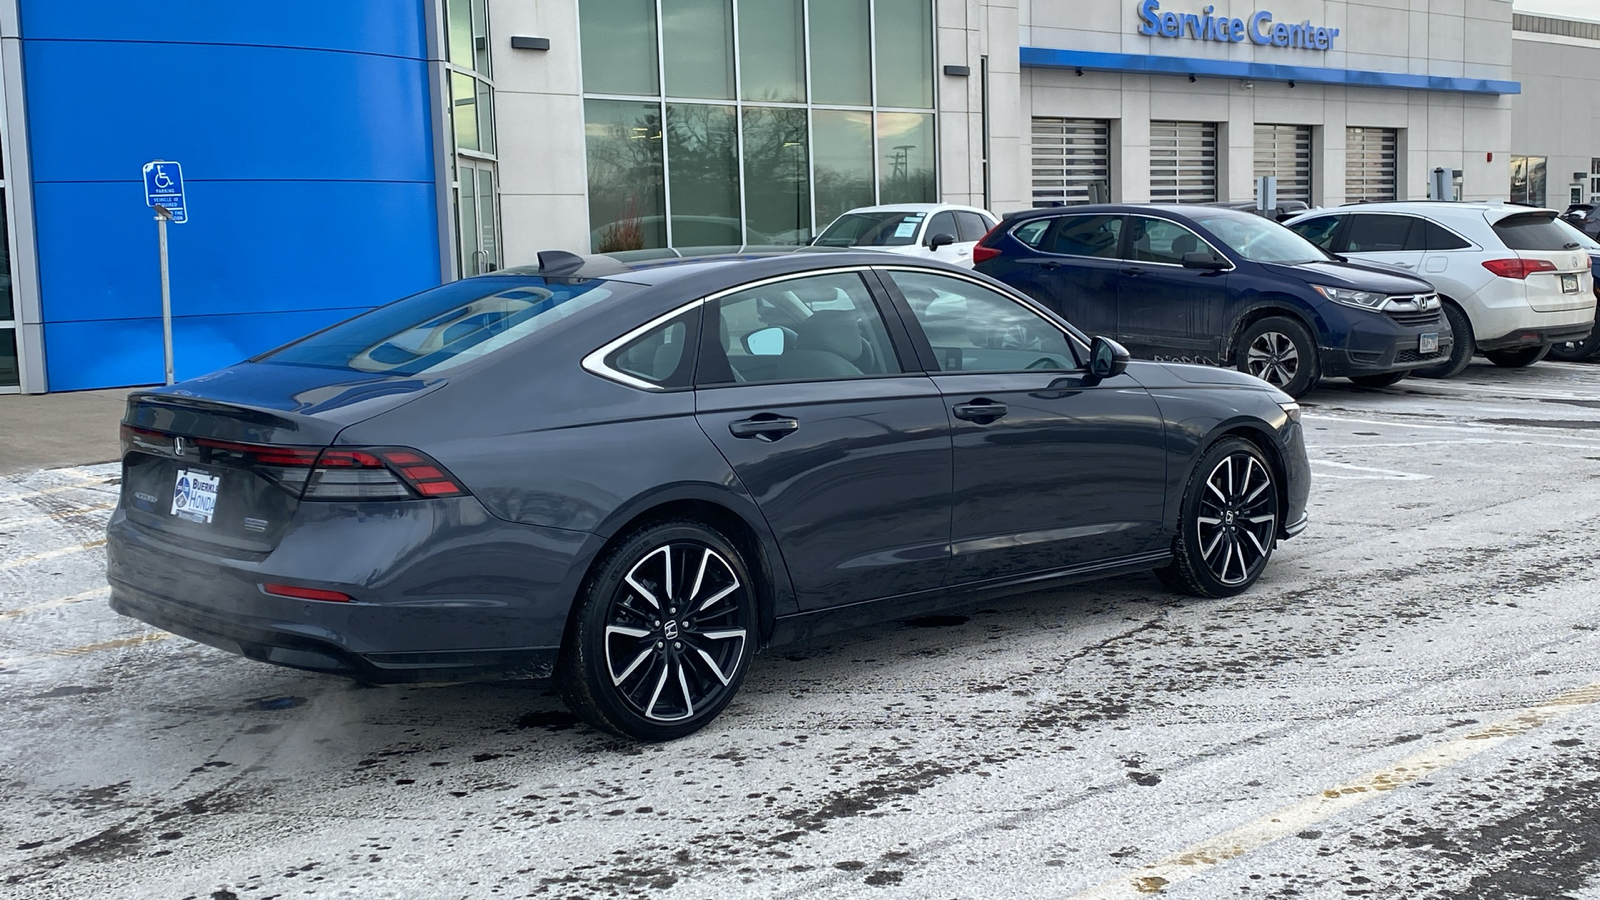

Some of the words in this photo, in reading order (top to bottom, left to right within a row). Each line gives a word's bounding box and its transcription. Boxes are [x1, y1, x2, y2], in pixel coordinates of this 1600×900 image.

[1138, 0, 1245, 43] Service
[1247, 10, 1340, 50] Center
[192, 478, 218, 494] BUERKLE
[189, 489, 216, 512] HONDA
